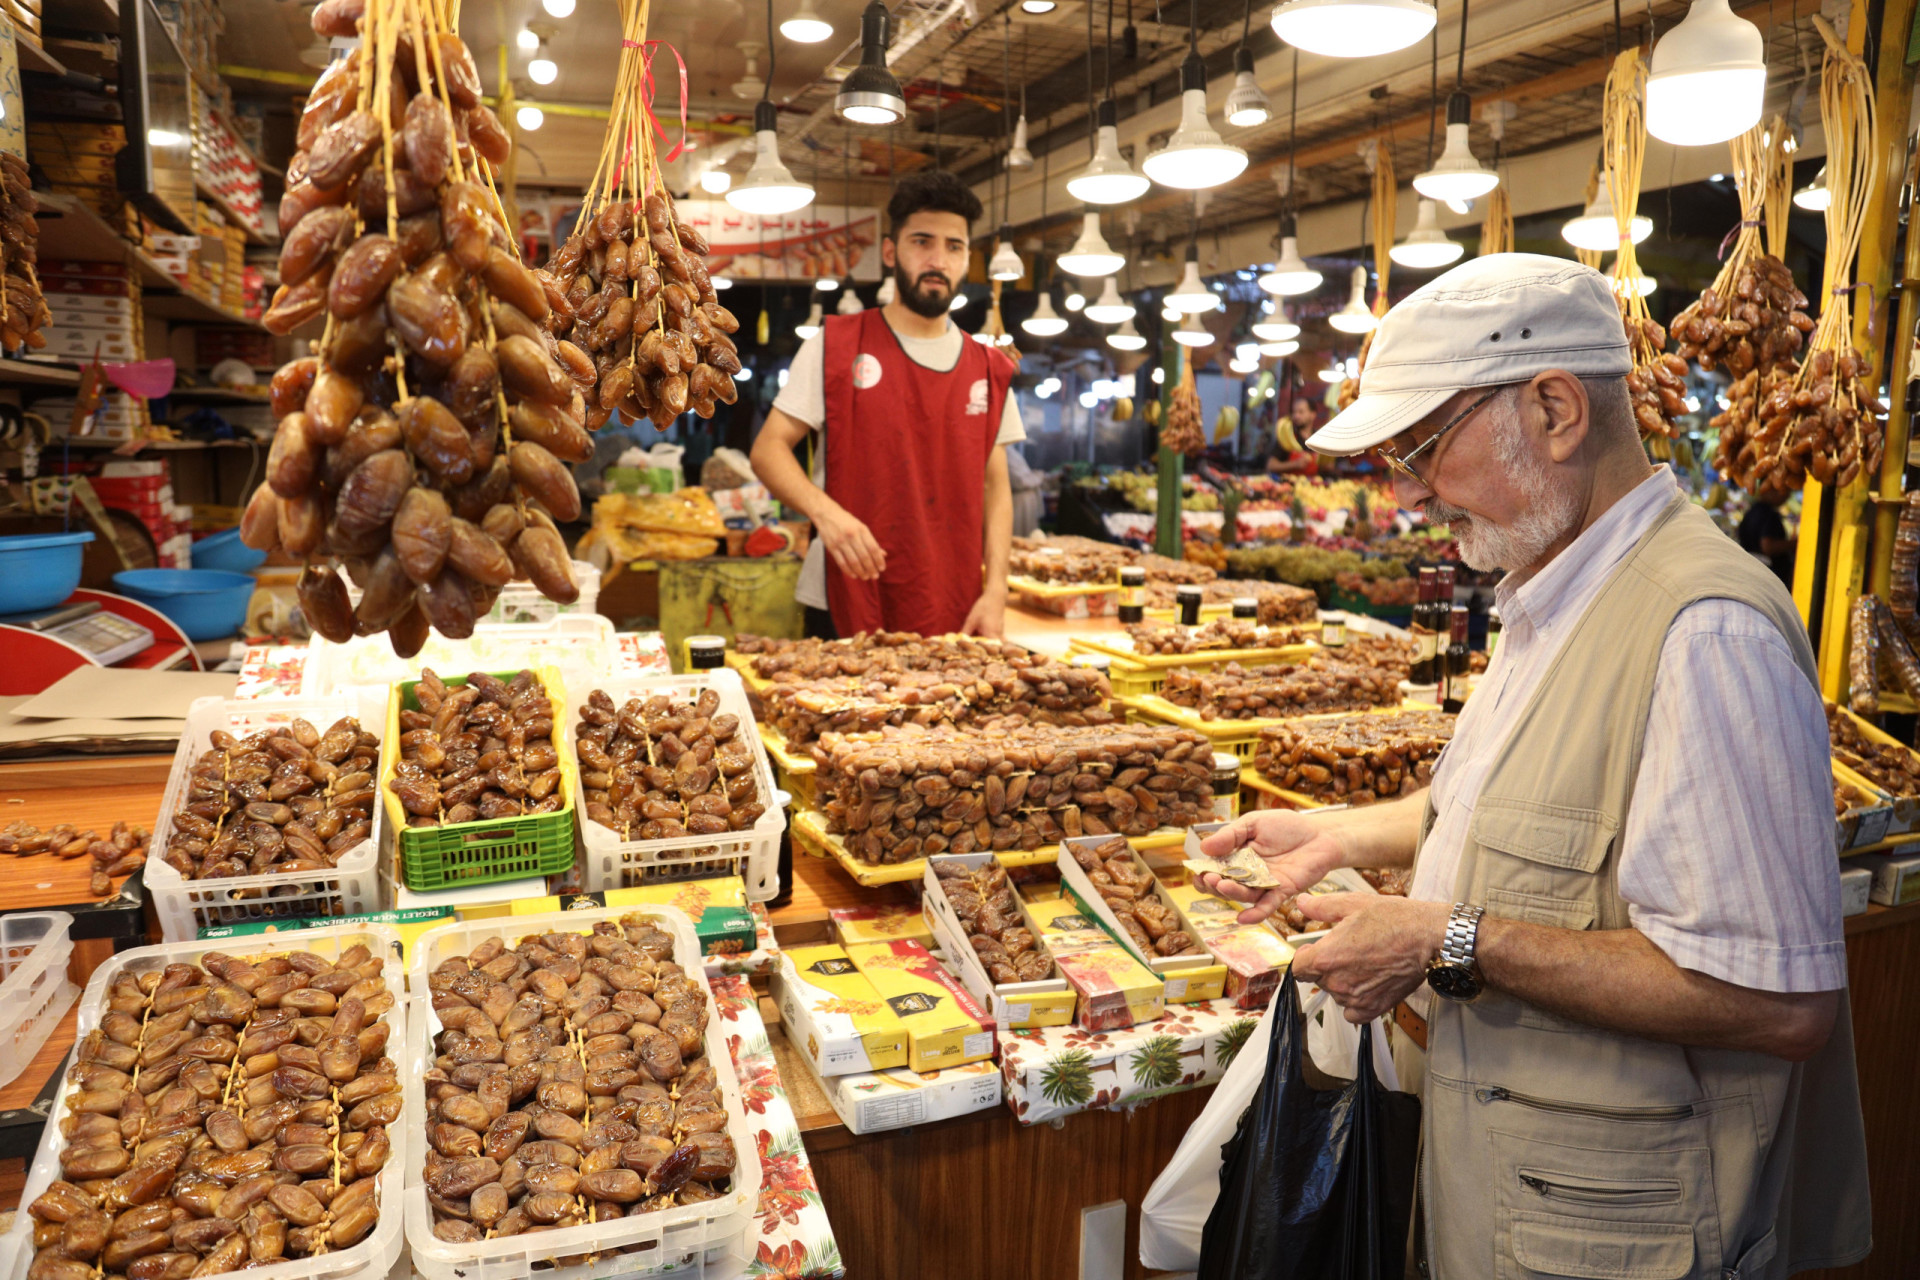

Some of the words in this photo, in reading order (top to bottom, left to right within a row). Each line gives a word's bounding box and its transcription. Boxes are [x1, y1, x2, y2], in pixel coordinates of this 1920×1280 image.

[373, 913, 400, 921] NOUR
[403, 910, 440, 919] DEGLET
[309, 915, 371, 927] ALGERIENNE
